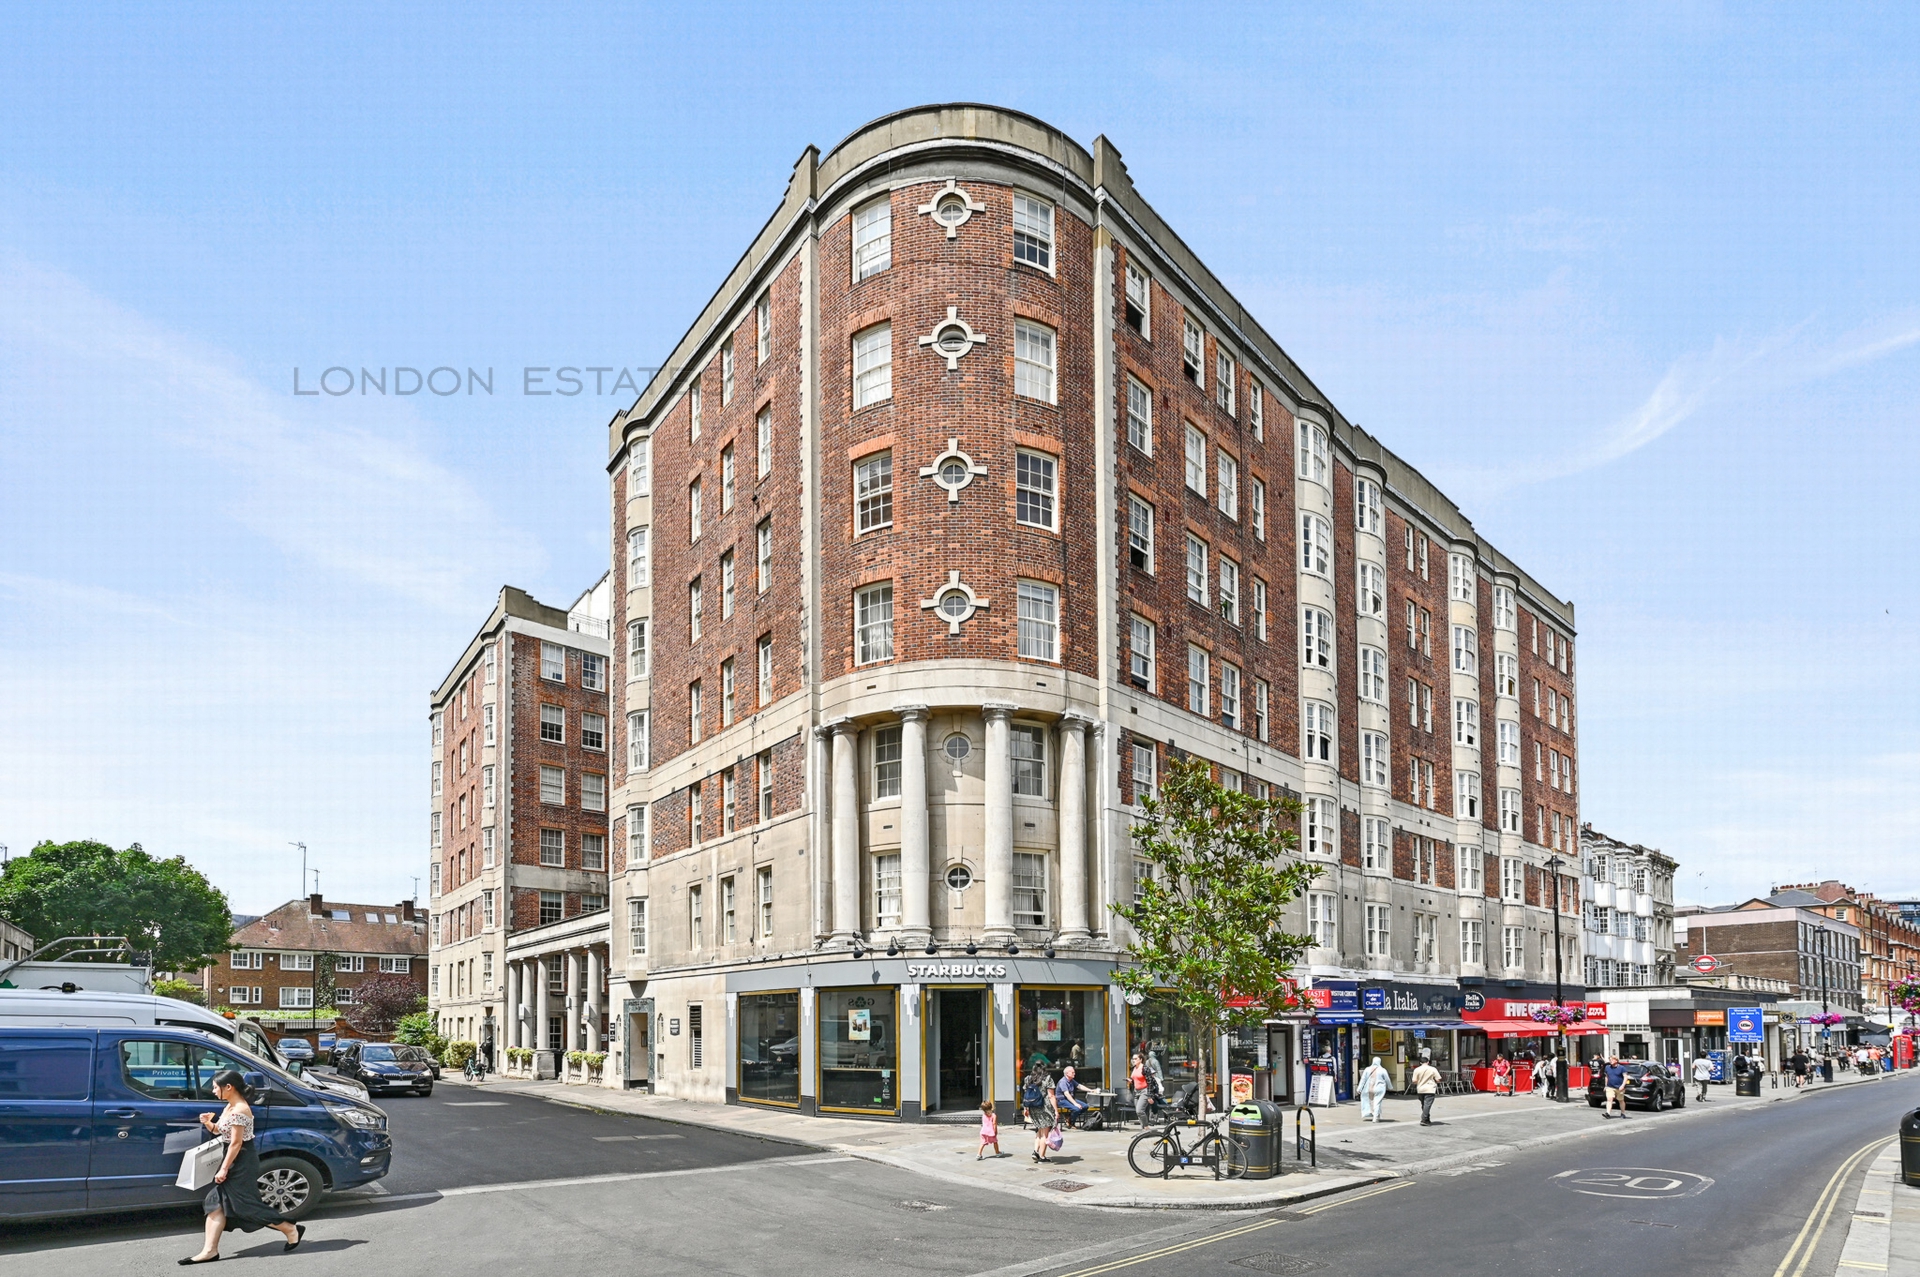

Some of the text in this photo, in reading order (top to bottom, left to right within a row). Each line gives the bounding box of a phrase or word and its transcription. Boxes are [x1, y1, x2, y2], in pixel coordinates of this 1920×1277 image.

[908, 964, 1006, 976] STARBUCKS
[1393, 990, 1419, 1011] Italia
[1504, 1002, 1528, 1017] FIVE
[1570, 1172, 1683, 1191] 20
